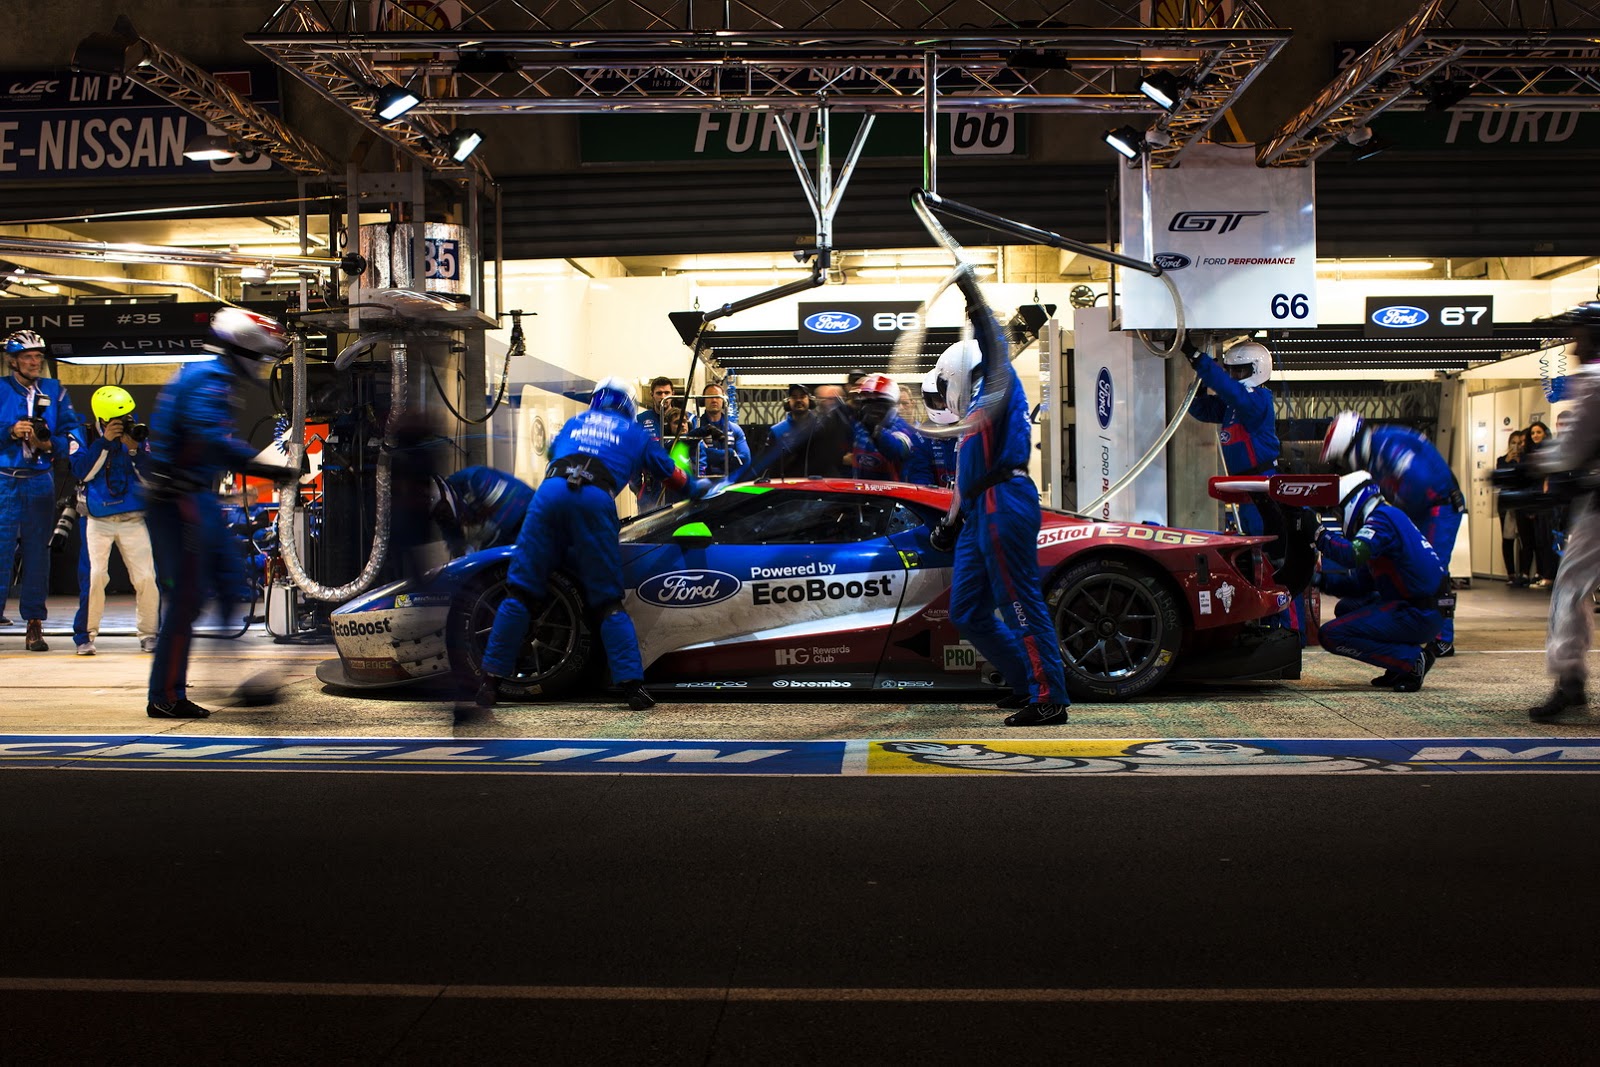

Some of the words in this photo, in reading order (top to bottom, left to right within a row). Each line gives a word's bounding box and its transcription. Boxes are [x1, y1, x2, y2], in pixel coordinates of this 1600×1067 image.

[68, 75, 100, 102] LM
[106, 75, 137, 101] P2
[694, 111, 820, 152] FORD
[954, 112, 1008, 149] 66
[1445, 111, 1581, 144] FORD
[1168, 210, 1269, 234] GT
[1203, 257, 1227, 266] FORD
[1227, 257, 1296, 266] PERFORMANCE
[1270, 293, 1310, 320] 66
[1440, 306, 1488, 326] 67
[5, 314, 86, 329] PINE
[116, 313, 162, 325] #35
[872, 312, 920, 331] 66
[101, 339, 204, 351] ALPINE
[1101, 445, 1110, 476] FORD
[1276, 481, 1333, 497] GT
[1037, 525, 1089, 546] astrol
[1098, 525, 1211, 545] EDGE
[750, 563, 817, 579] Powered
[818, 562, 837, 576] by
[751, 574, 893, 606] EcoBoost
[1012, 600, 1029, 627] FORD
[334, 617, 392, 637] EcoBoost
[775, 647, 810, 666] IHG
[812, 646, 850, 655] Rewards
[812, 654, 835, 664] Club
[945, 648, 975, 667] PRO
[790, 680, 852, 688] brembo
